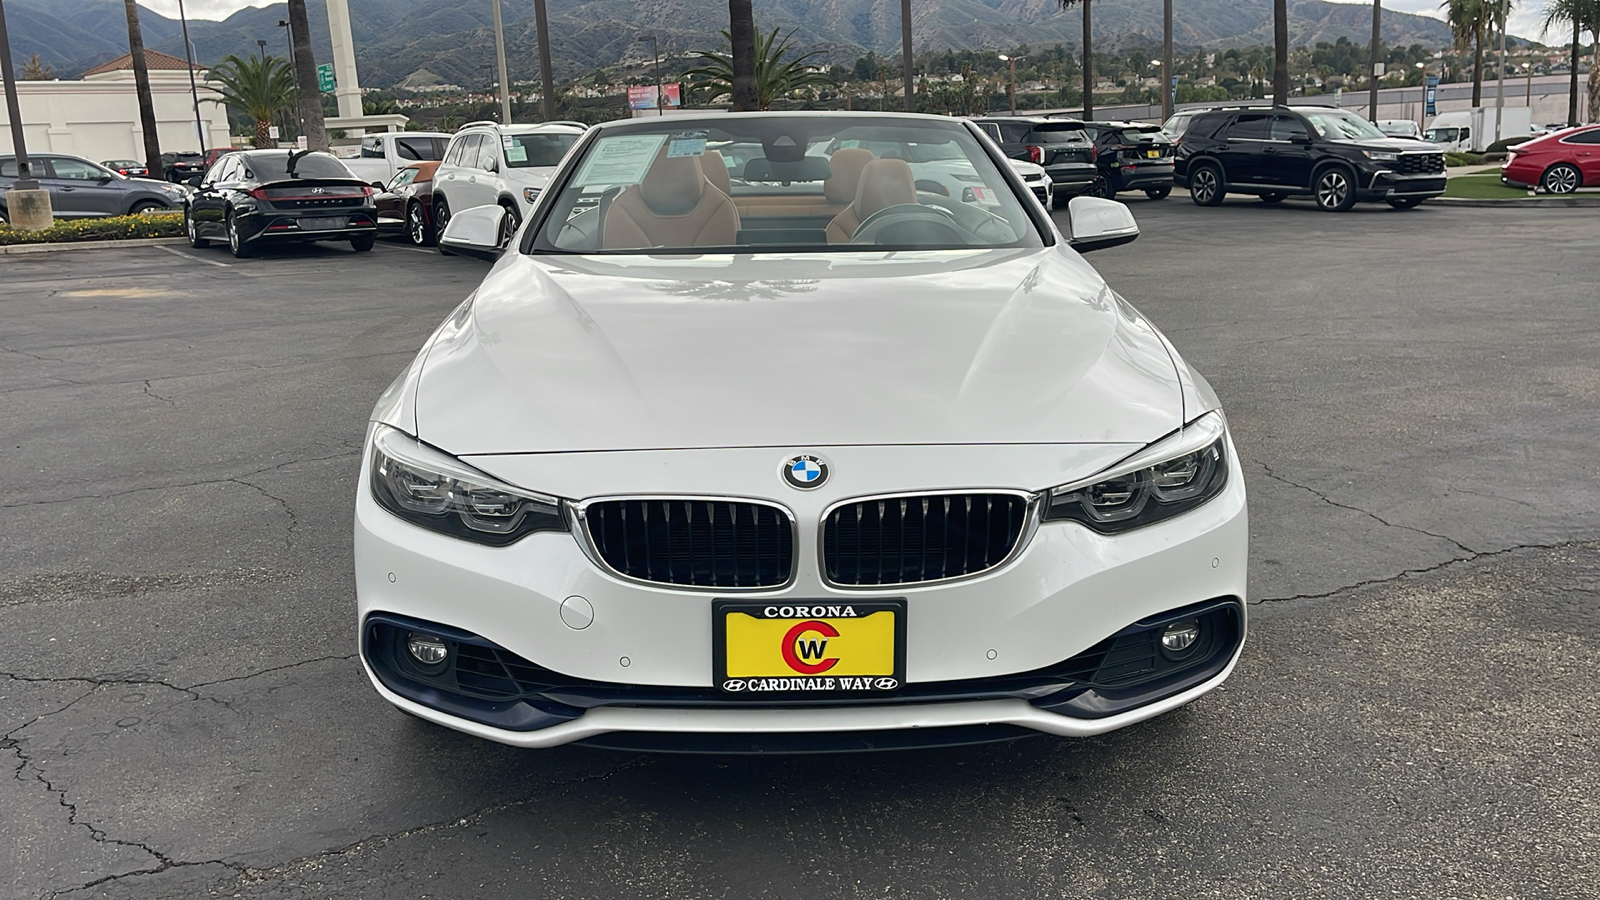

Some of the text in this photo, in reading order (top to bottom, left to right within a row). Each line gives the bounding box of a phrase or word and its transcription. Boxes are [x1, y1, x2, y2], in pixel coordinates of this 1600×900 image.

[787, 455, 825, 466] BMW
[763, 605, 858, 618] CORONA
[748, 676, 874, 692] CARDINALE WAY
